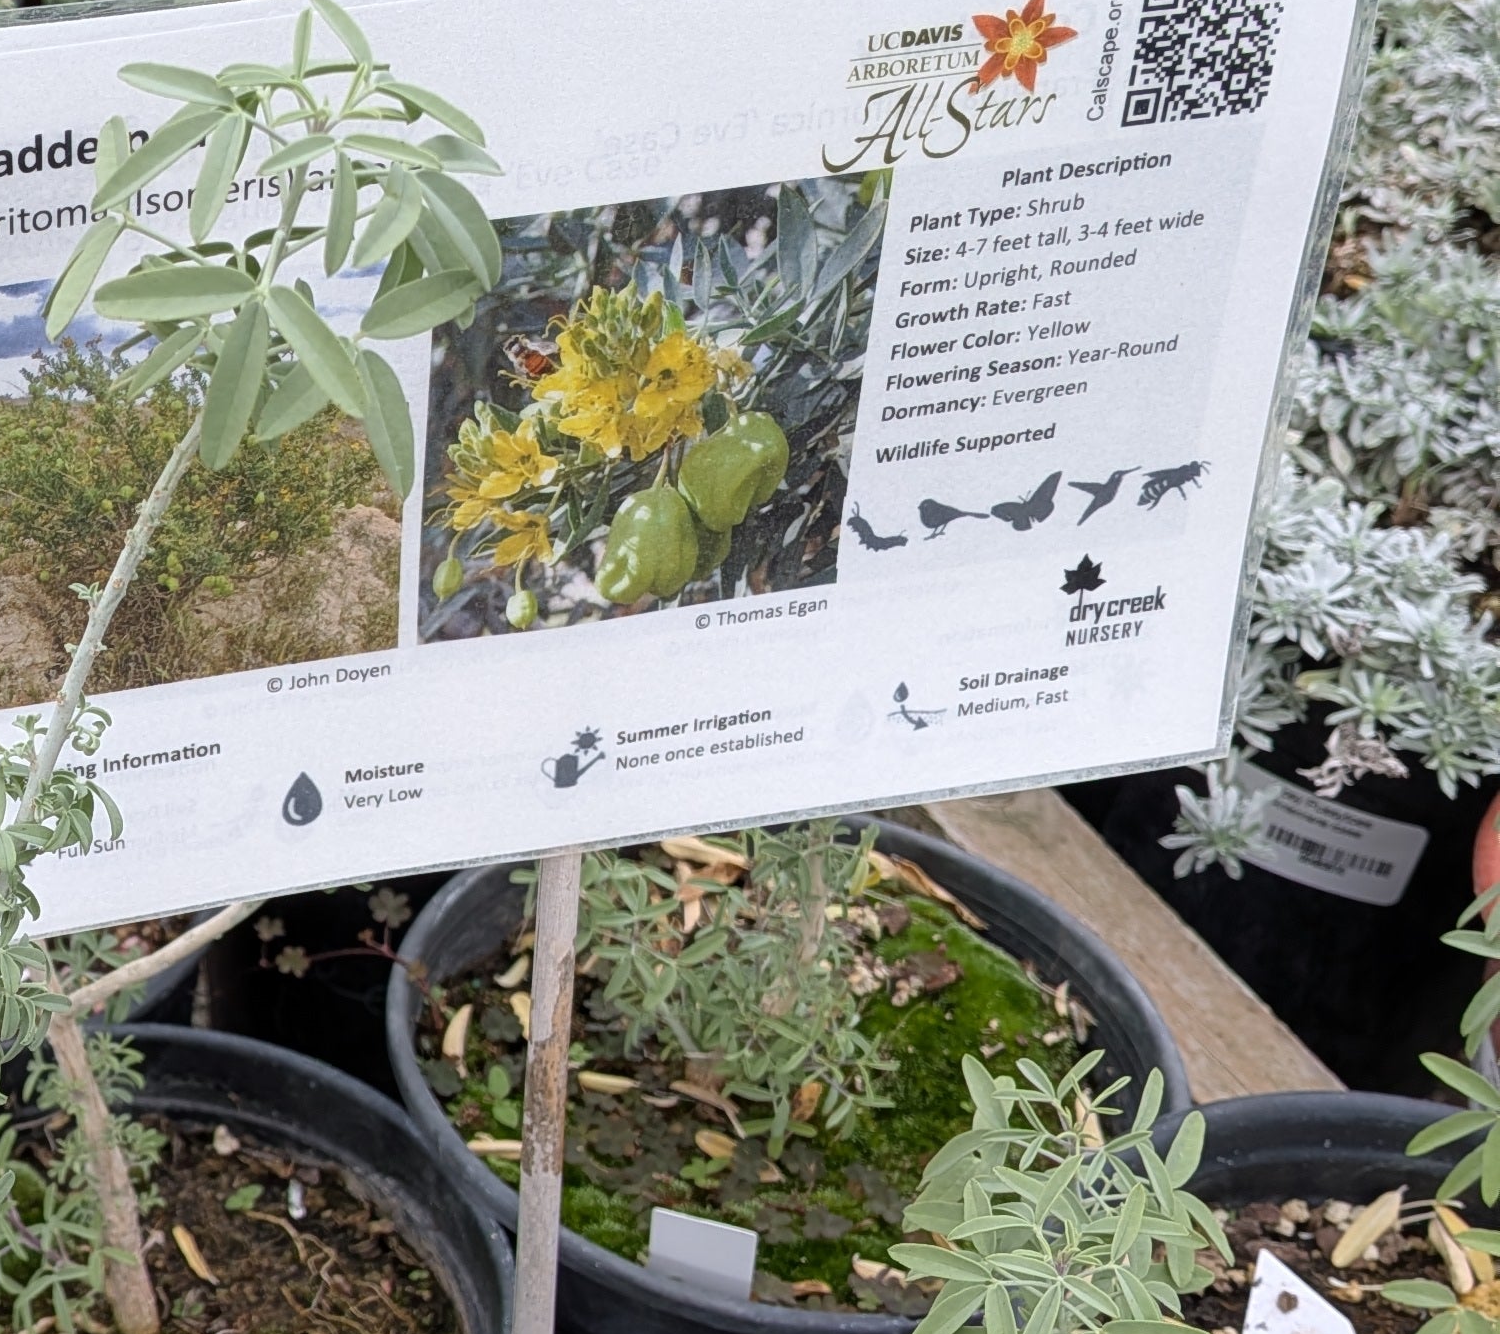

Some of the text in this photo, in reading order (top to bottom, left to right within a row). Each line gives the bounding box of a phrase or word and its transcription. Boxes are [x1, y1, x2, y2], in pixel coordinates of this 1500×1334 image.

[846, 49, 981, 83] ARBORETUM
[820, 76, 1057, 173] All-Stars
[1000, 151, 1172, 188] Plant Description
[908, 191, 1085, 233] Plant Type: Shrub
[903, 208, 1205, 266] Size: 4-7 feet tall, 3-4 feet wide
[898, 247, 1138, 298] Form: Upright, Rounded
[894, 289, 1072, 329] Growth Rate: Fast
[889, 319, 1091, 361] Flower Color: Yellow
[884, 333, 1179, 392] Flowering Season: Year-Round
[880, 380, 1088, 422] Dormancy: Evergreen
[874, 421, 1057, 464] Wildlife Supported
[715, 605, 783, 626] Thomas
[787, 598, 828, 618] Egan
[1064, 619, 1144, 647] NURSERY
[287, 671, 329, 691] John
[335, 663, 391, 683] Doyen
[957, 664, 1069, 692] Soil Drainage
[956, 688, 1069, 717] Medium, Fast
[615, 708, 772, 746] Summer Irrigation
[102, 742, 221, 773] Information
[615, 725, 804, 771] None once established
[344, 761, 425, 784] Moisture
[342, 787, 423, 809] Very Low
[93, 838, 126, 855] Sun
